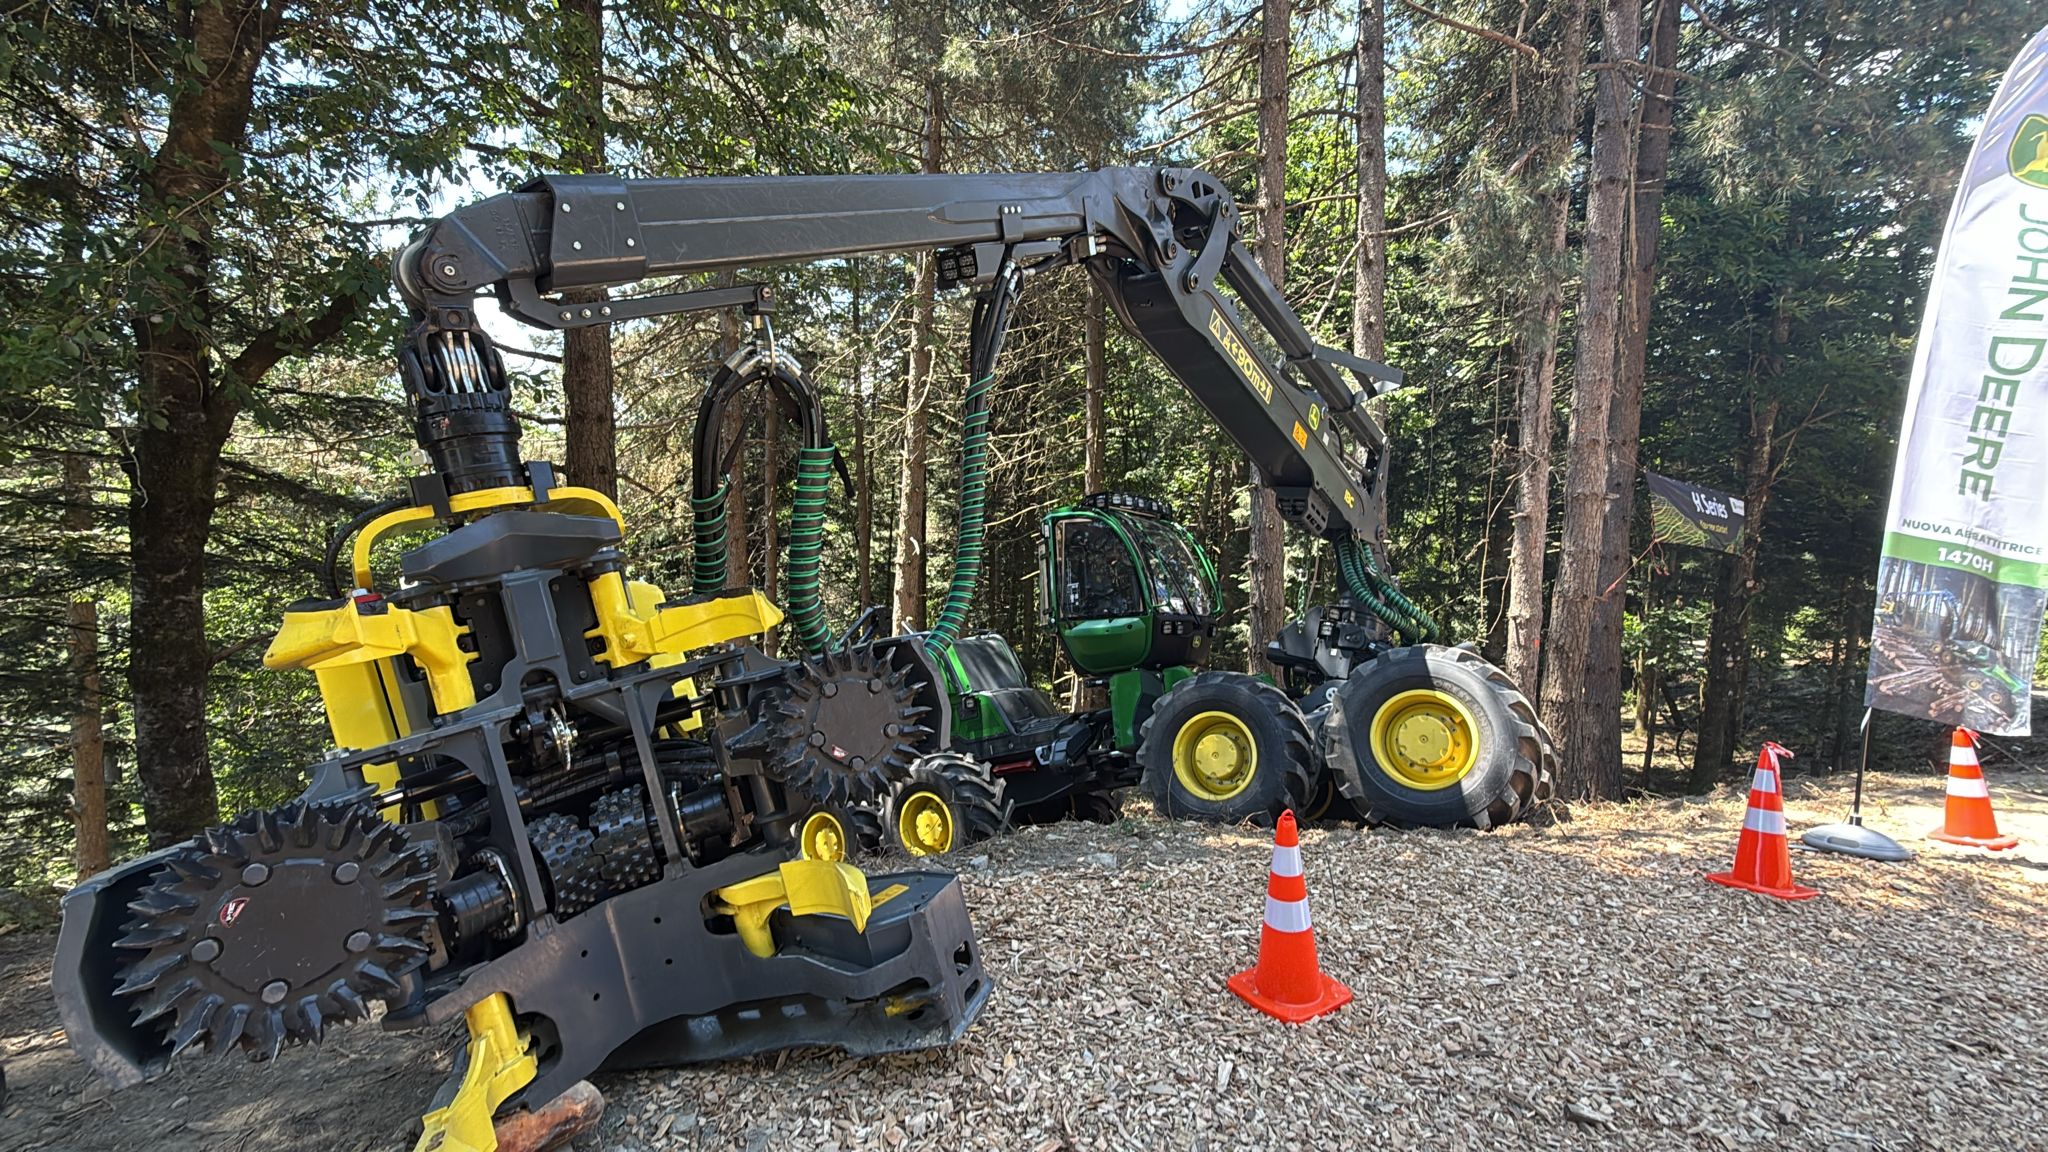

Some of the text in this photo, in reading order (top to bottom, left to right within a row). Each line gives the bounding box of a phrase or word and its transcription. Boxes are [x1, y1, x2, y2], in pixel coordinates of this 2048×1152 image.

[1958, 203, 2048, 503] JOHN DEERE
[1691, 491, 1705, 513] H
[1700, 493, 1729, 519] Series
[1902, 518, 2042, 556] NUOVA ABBATTITRICE
[1937, 547, 1994, 574] 1470H
